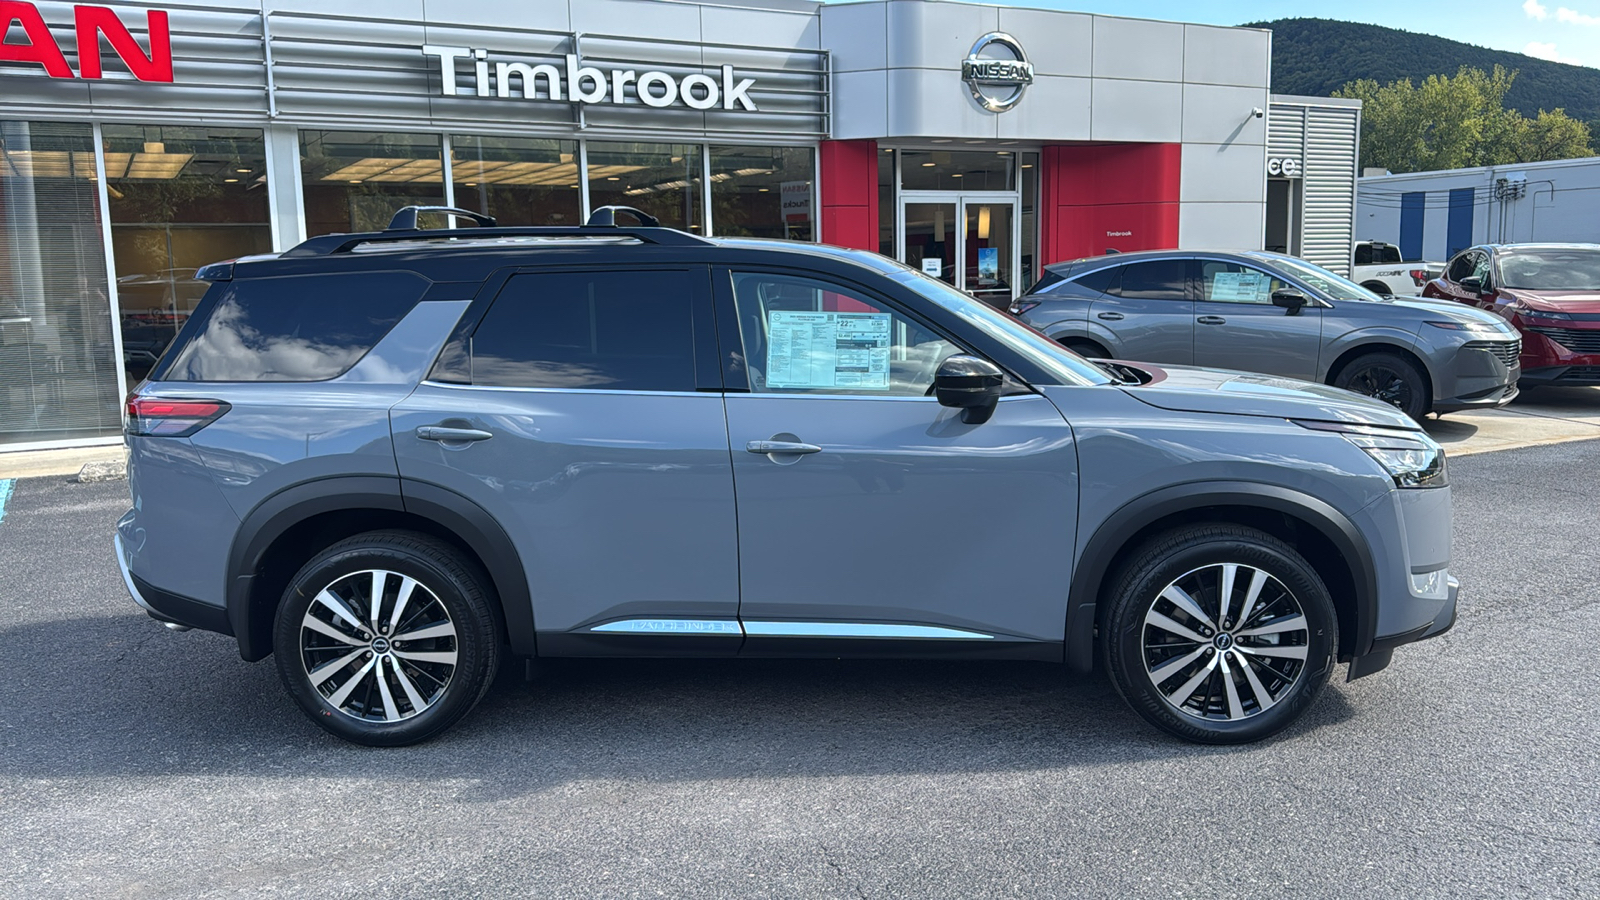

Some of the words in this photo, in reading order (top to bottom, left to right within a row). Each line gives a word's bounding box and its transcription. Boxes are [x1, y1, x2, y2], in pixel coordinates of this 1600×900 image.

[0, 1, 174, 83] AN
[422, 45, 759, 112] Timbrook
[971, 63, 1029, 80] NISSAN
[630, 620, 735, 632] PATHFINDER
